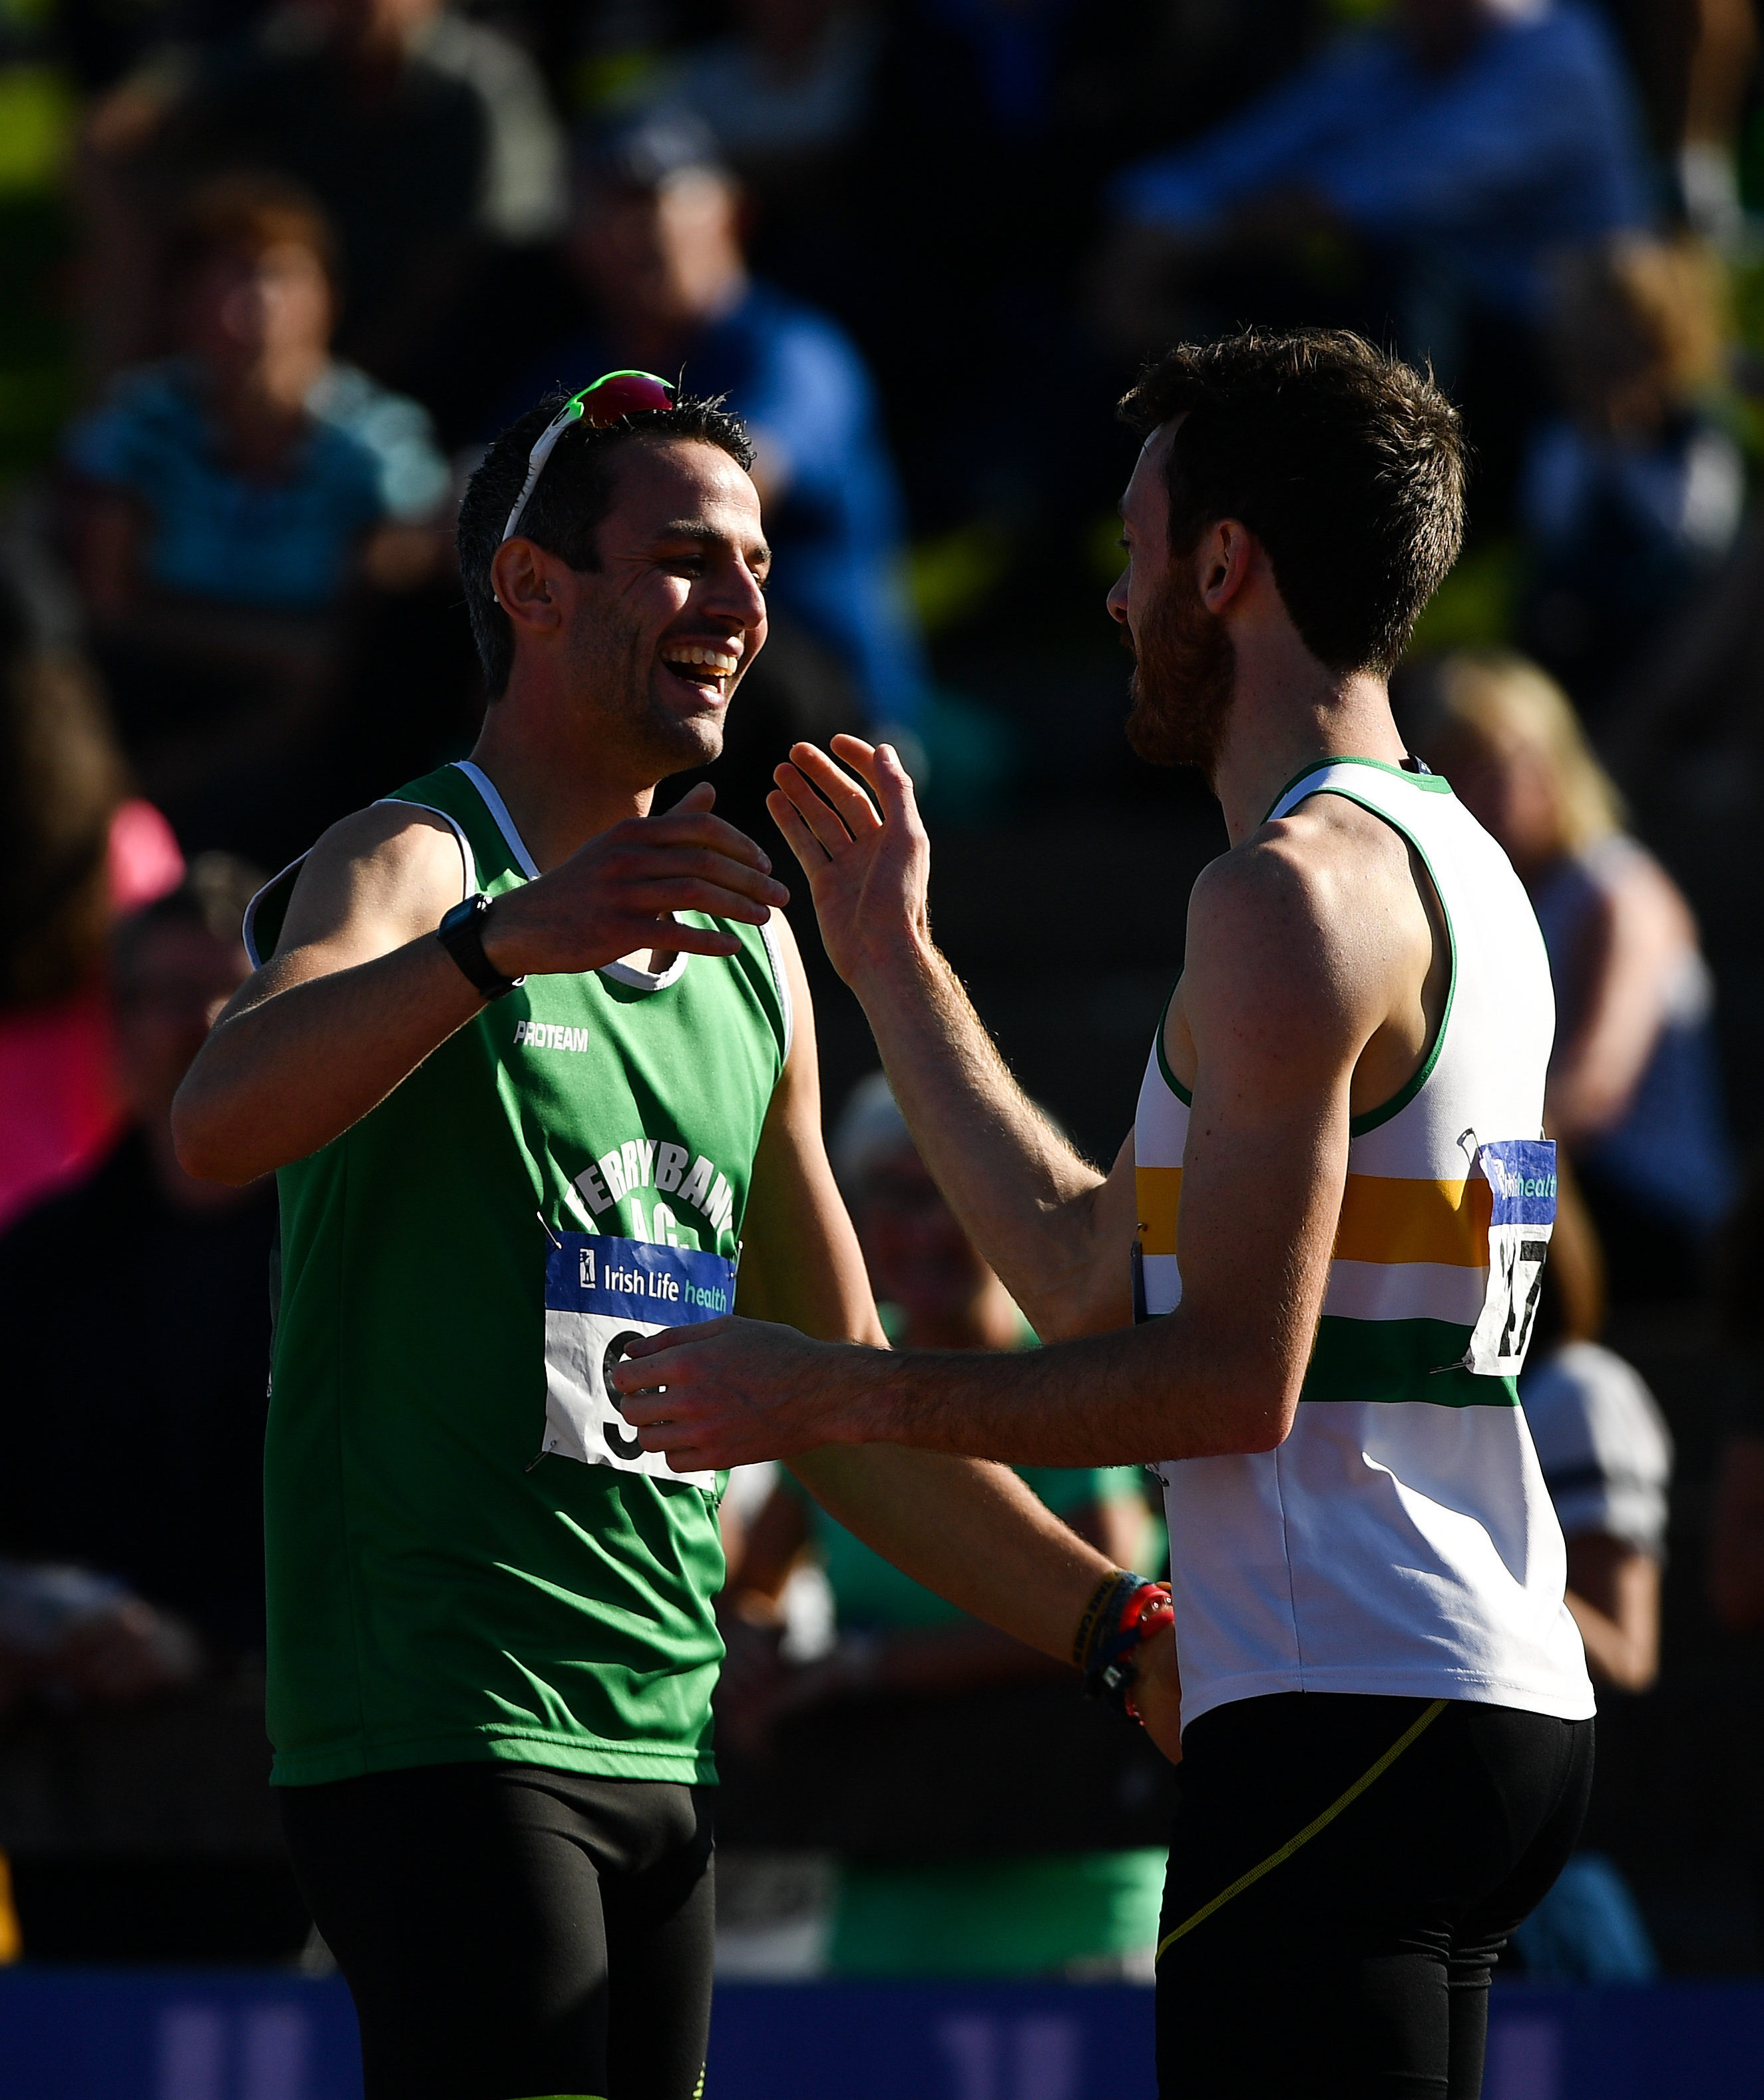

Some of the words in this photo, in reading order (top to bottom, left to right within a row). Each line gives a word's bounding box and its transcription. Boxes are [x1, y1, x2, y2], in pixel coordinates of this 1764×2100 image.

[513, 1019, 588, 1053] PROTEAM
[1518, 1172, 1557, 1198] healt
[604, 1264, 644, 1296] Irish
[648, 1271, 680, 1302] Life
[684, 1279, 728, 1313] health
